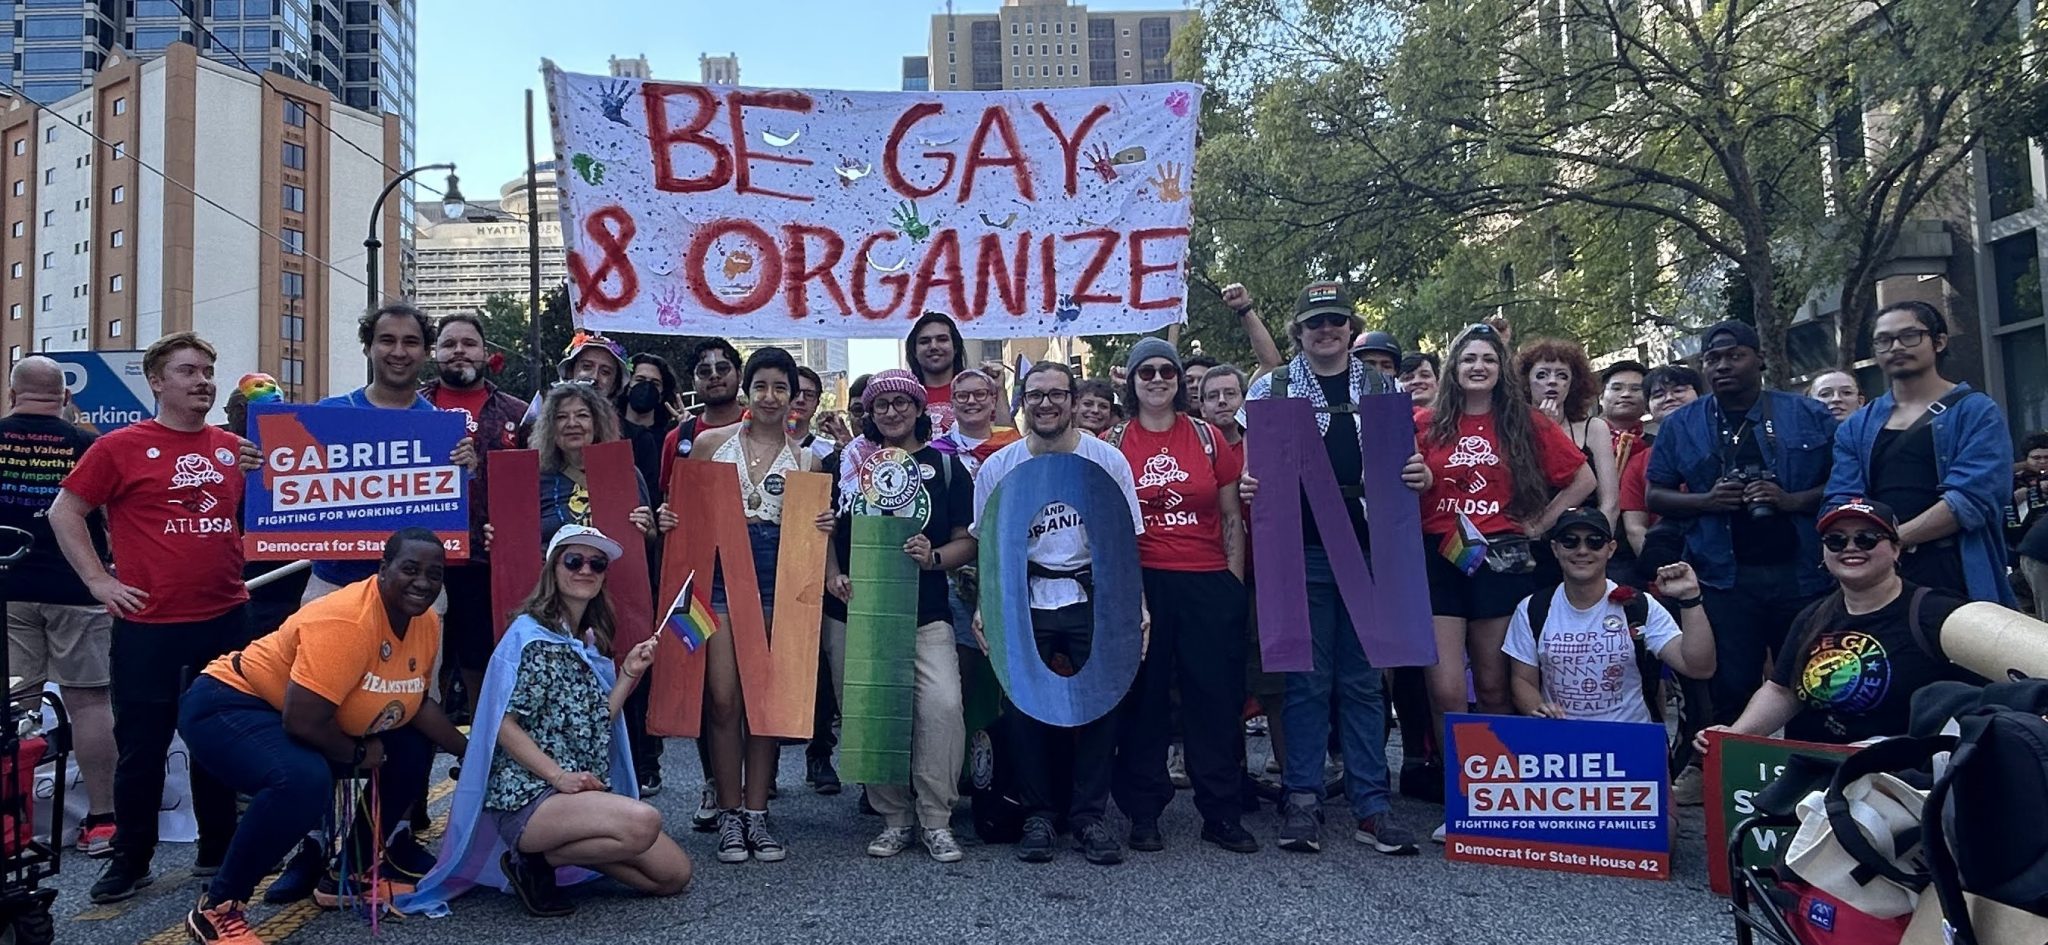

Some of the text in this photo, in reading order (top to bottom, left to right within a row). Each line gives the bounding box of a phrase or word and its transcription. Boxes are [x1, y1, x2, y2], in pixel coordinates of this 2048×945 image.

[641, 81, 1112, 204] BE GAY
[477, 226, 517, 235] HYATT
[566, 204, 1192, 323] & ORGANIZE
[3, 432, 65, 442] You Matter
[0, 443, 75, 456] ou are Valued
[269, 440, 432, 472] GABRIEL
[8, 457, 27, 467] are
[29, 458, 65, 468] Worth
[864, 450, 909, 472] BE GAY
[19, 484, 61, 495] Respec
[279, 470, 454, 505] SANCHEZ
[880, 474, 918, 507] ORGANIZE
[257, 501, 459, 526] FIGHTING FOR WORKING FAMILIES
[1044, 504, 1066, 517] AND
[1144, 511, 1199, 527] TLDSA
[163, 518, 232, 535] ATLDSA
[1027, 513, 1084, 539] RGANI
[257, 539, 461, 553] Democrat for Stat 42
[490, 391, 1438, 785] UNION
[1543, 631, 1598, 642] LABOR
[1550, 652, 1630, 666] CREATES
[1559, 695, 1624, 712] WEALTH
[1464, 753, 1626, 779] GABRIEL
[1474, 787, 1652, 811] SANCHEZ
[1455, 819, 1657, 830] FIGHTING FOR WORKING FAMILIES
[1455, 842, 1659, 872] Democrat for State House 42
